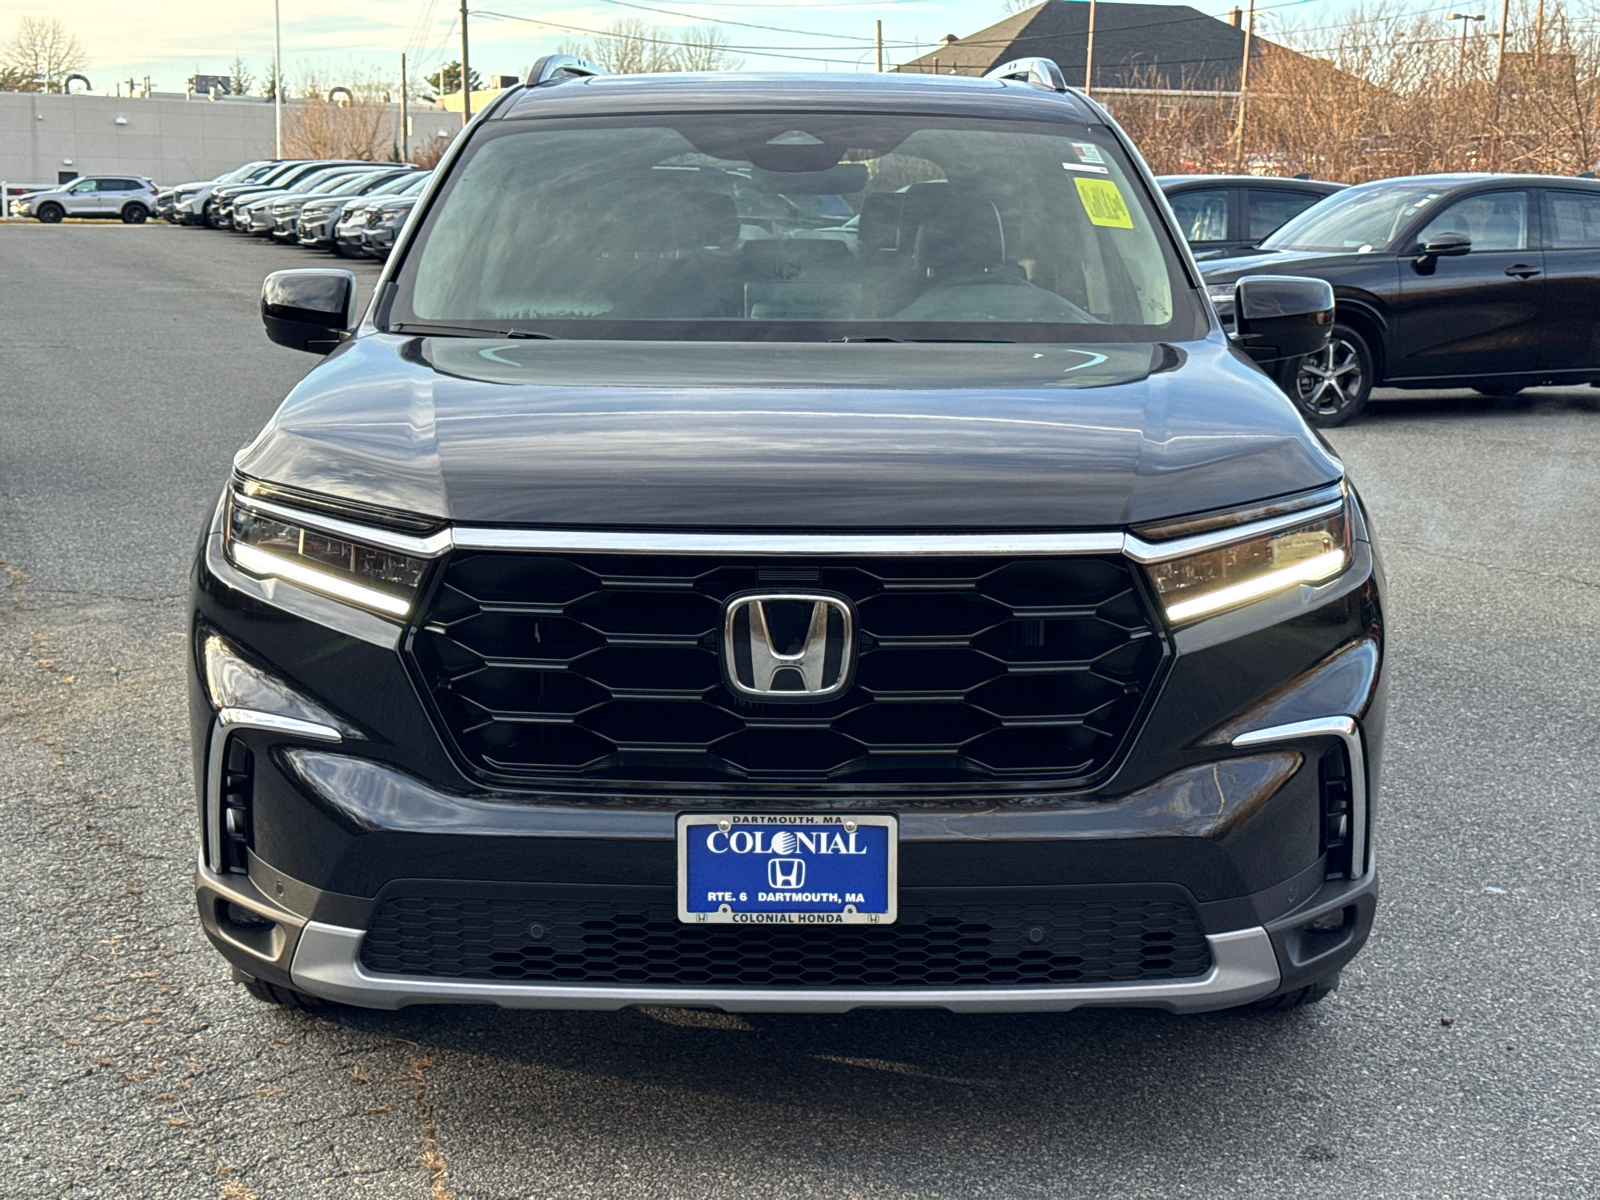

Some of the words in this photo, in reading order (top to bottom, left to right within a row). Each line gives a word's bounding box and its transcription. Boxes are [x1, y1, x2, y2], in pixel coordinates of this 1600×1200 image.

[822, 816, 842, 824] MA
[706, 830, 867, 855] COLONIAL
[707, 892, 736, 902] RTE.
[739, 892, 748, 902] 6
[758, 892, 842, 904] DARTMOUTH,
[845, 893, 865, 903] MA
[732, 913, 794, 923] COLONIAL
[798, 914, 843, 923] HONDA
